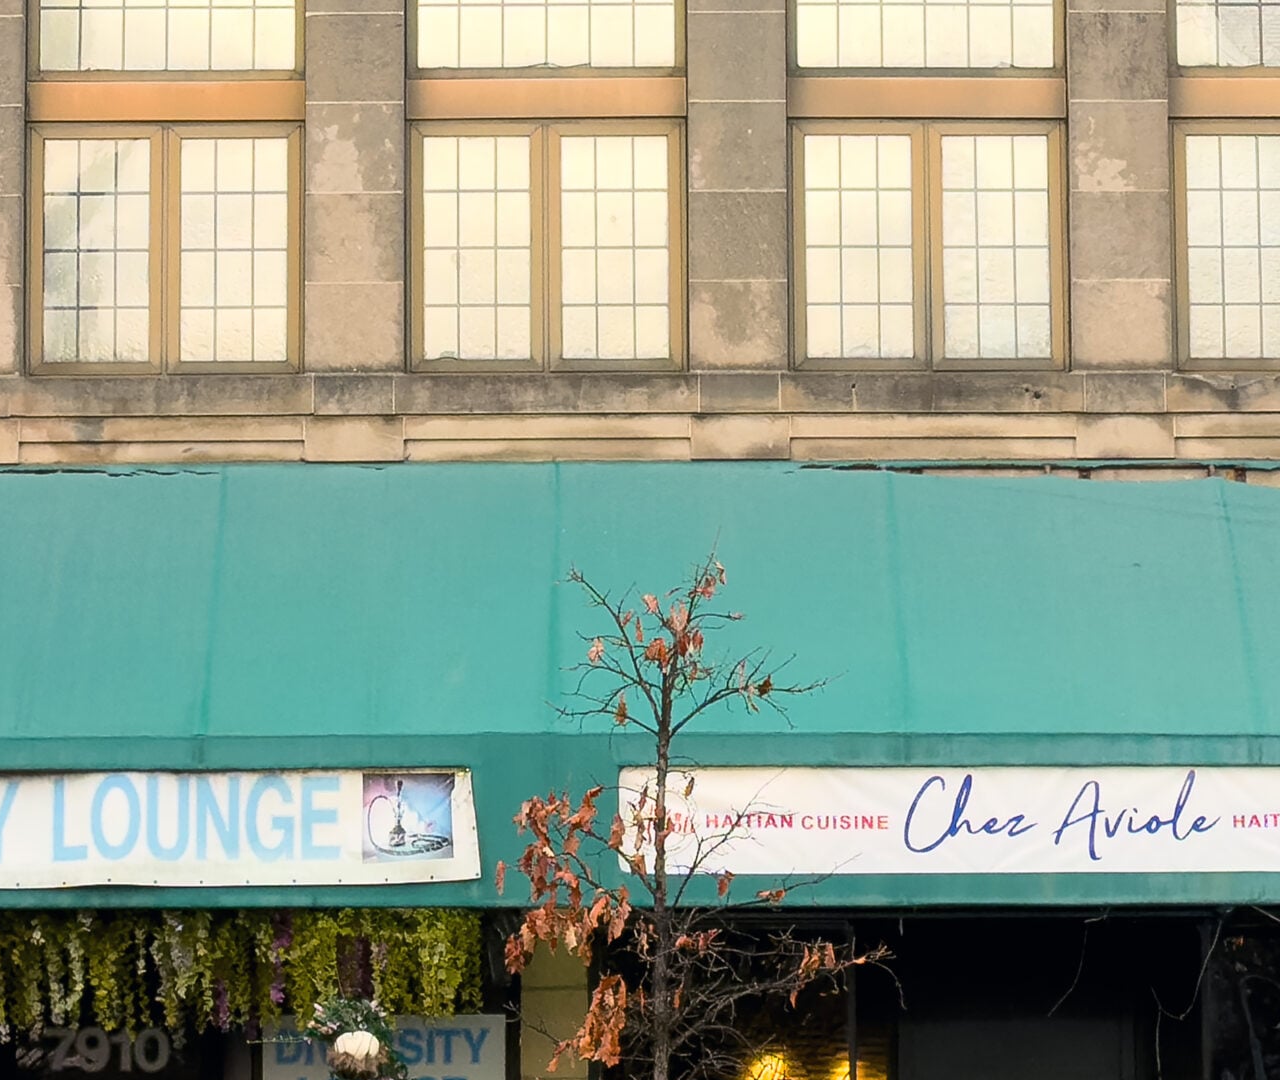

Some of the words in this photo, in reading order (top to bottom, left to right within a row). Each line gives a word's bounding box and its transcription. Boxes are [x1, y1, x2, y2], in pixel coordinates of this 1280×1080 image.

[51, 773, 341, 862] LOUNGE
[705, 814, 794, 830] HAITIAN
[802, 815, 889, 831] CUISINE
[904, 774, 1038, 853] Chez
[1053, 769, 1221, 861] Aviole
[42, 1026, 170, 1073] 7910
